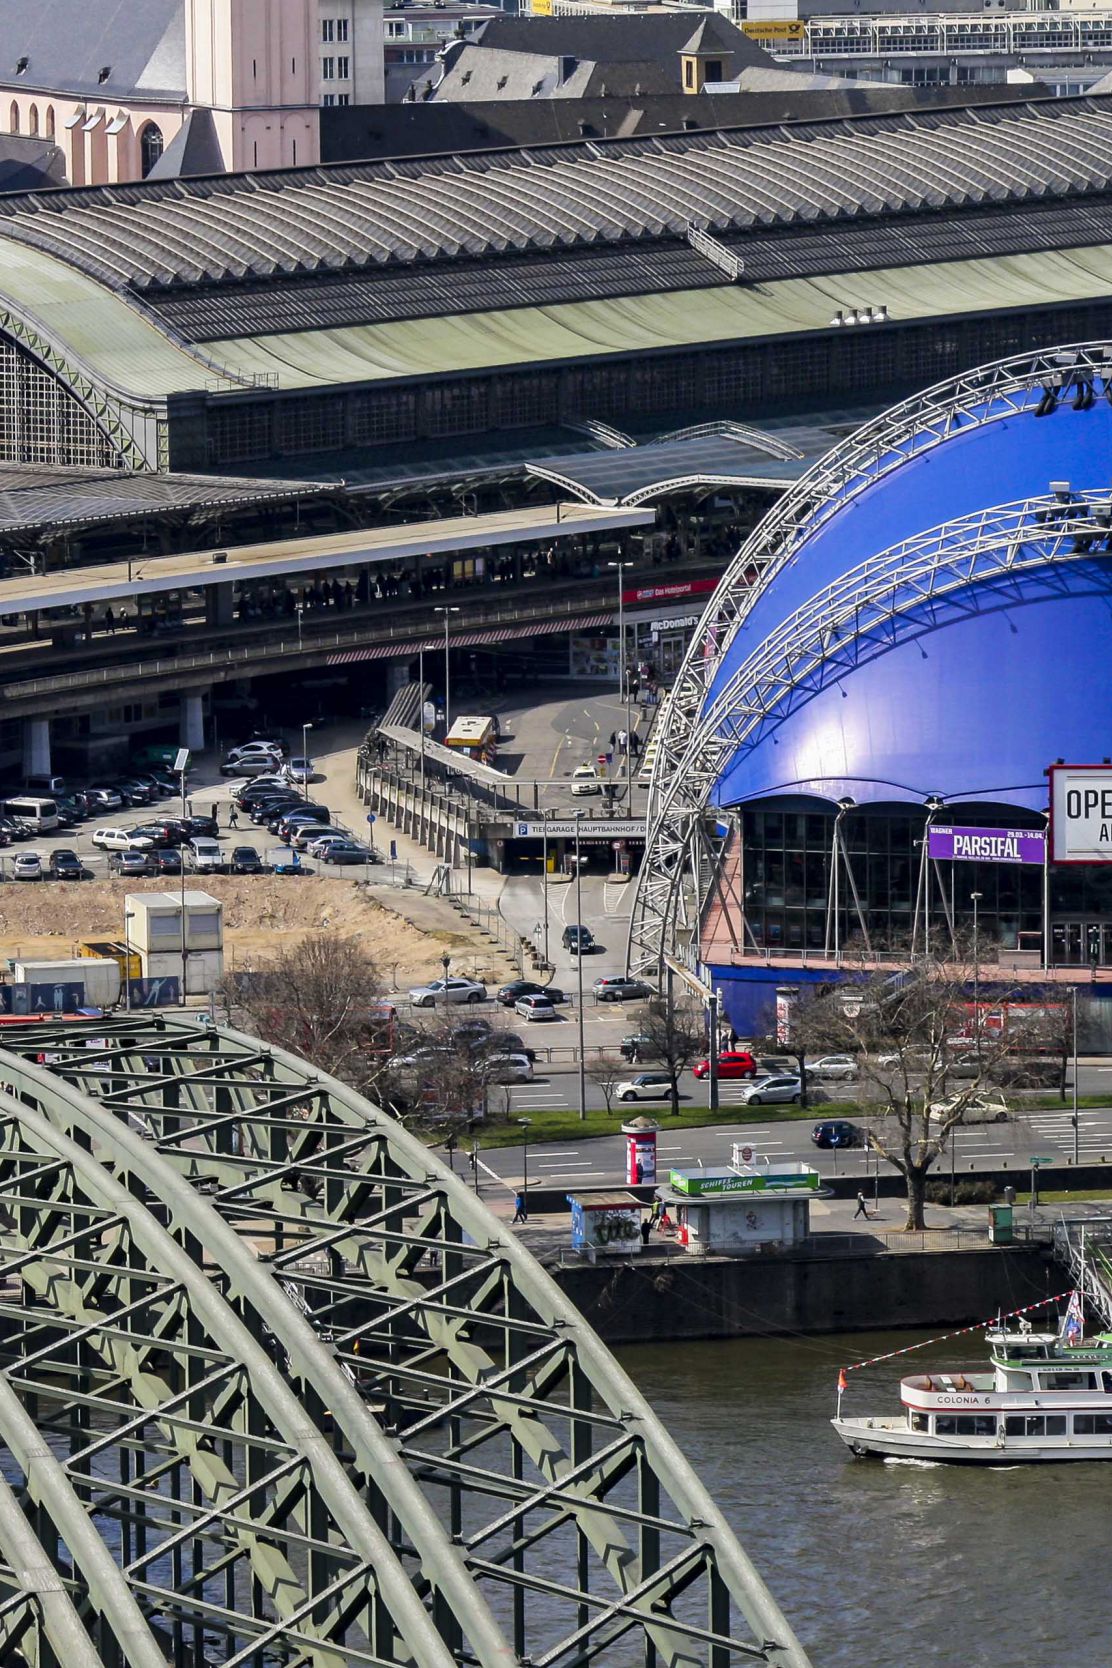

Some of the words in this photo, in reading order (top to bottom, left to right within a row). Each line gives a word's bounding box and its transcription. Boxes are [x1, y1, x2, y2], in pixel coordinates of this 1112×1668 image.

[650, 616, 699, 631] McDonald's
[953, 835, 1021, 858] PARSIFAL
[700, 1178, 734, 1189] SCHIFFS-
[722, 1179, 753, 1190] TOUREN
[937, 1396, 979, 1404] COLONIA
[984, 1396, 991, 1404] 6
